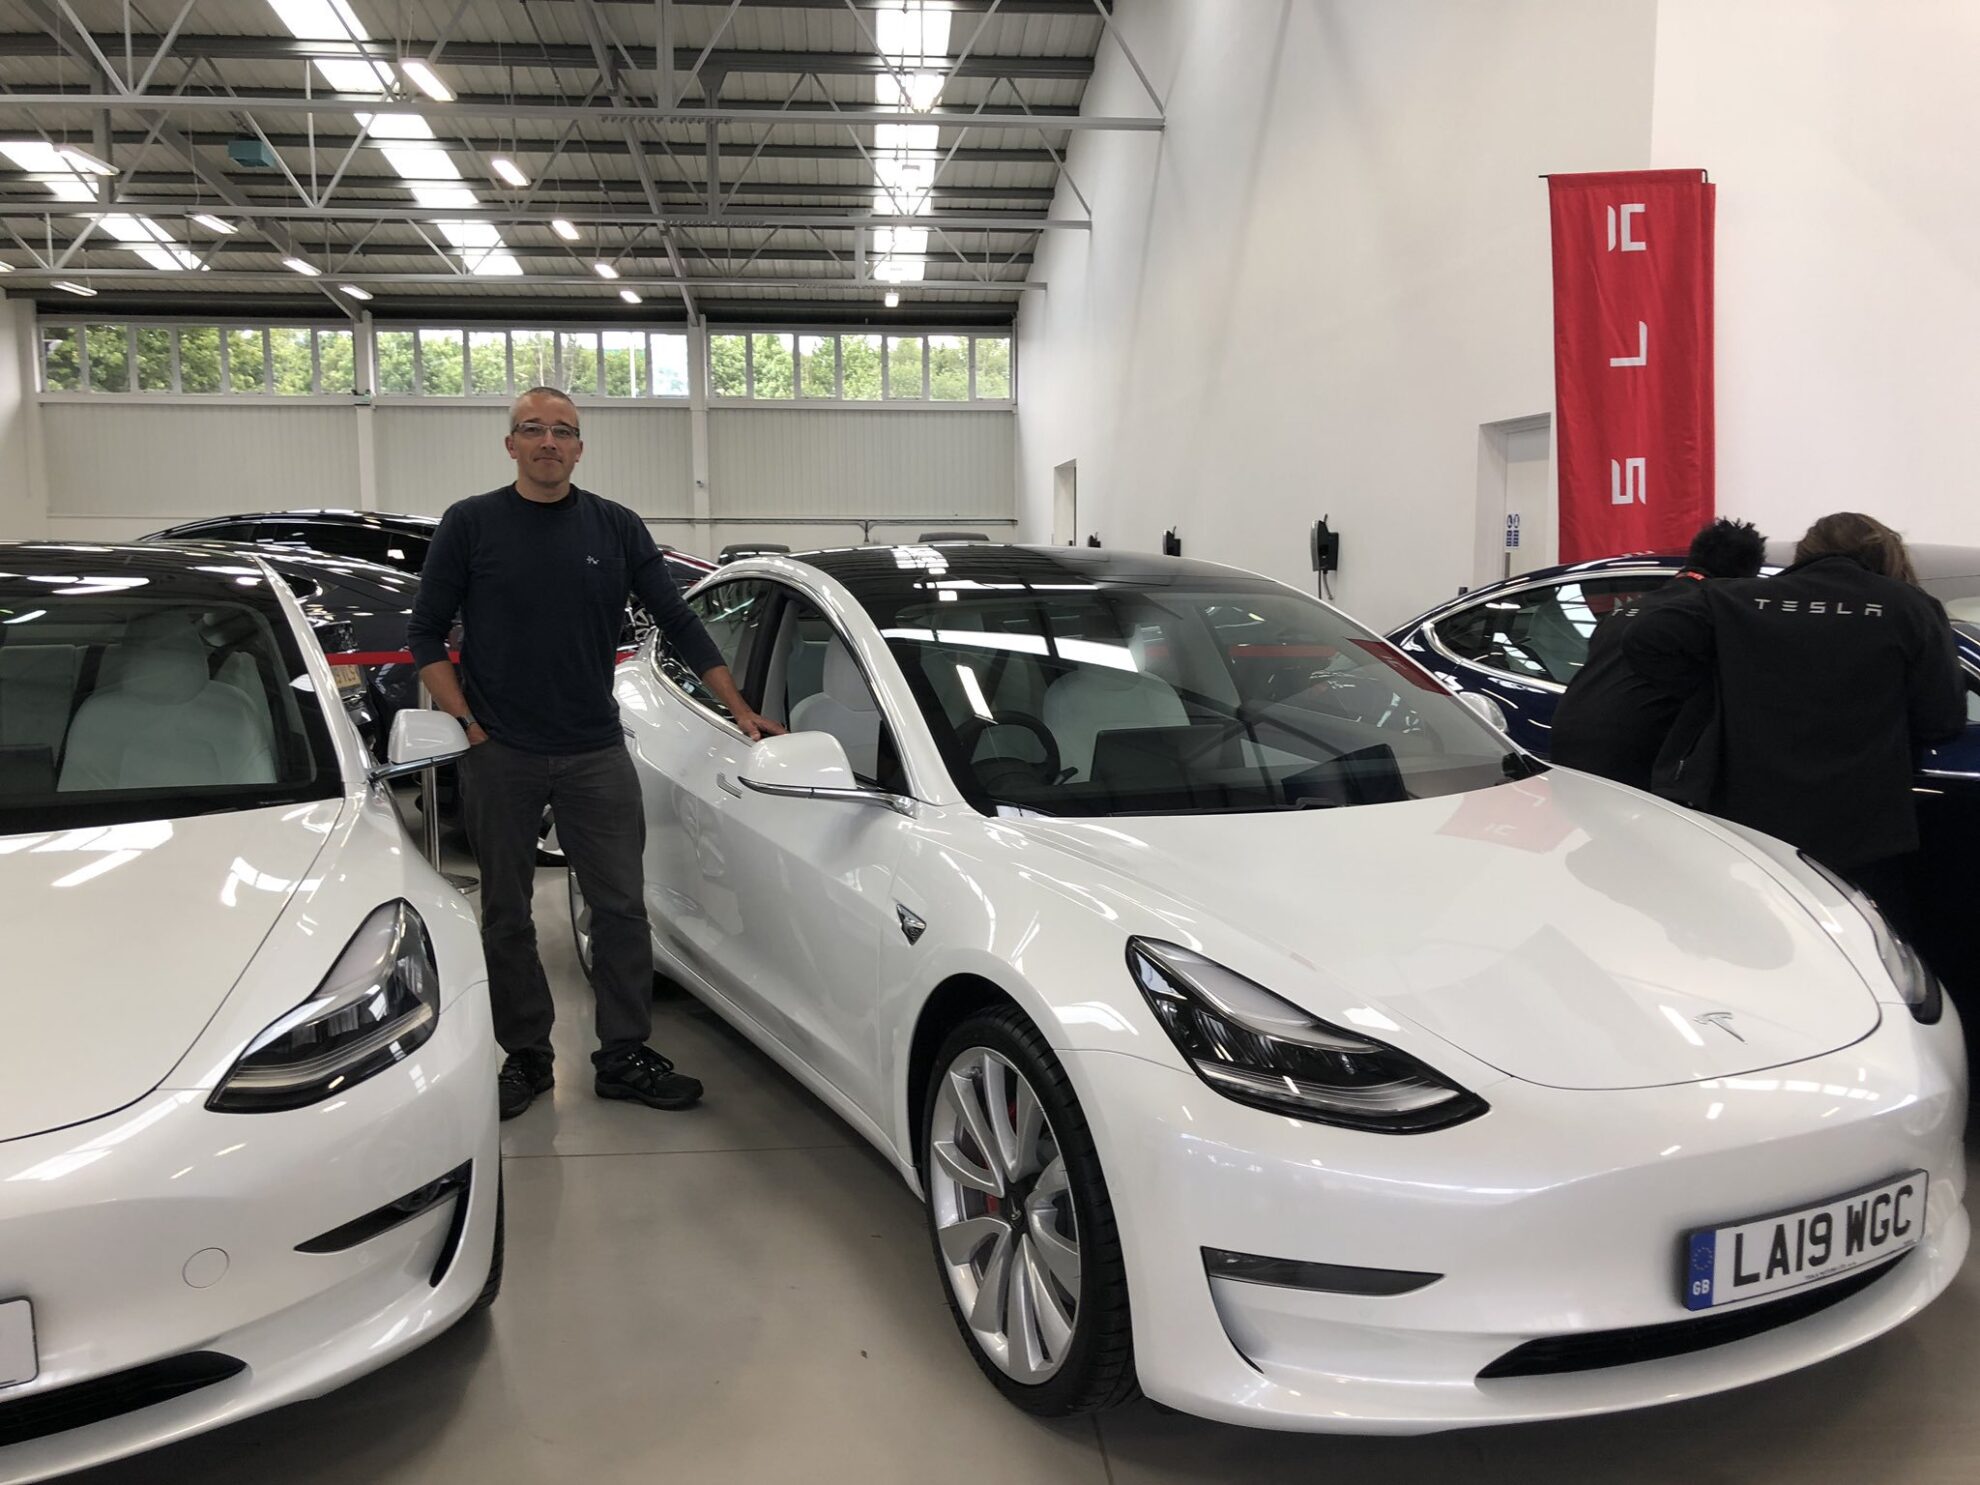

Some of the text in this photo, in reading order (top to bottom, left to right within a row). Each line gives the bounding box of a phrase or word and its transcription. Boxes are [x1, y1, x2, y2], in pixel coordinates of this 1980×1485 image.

[1607, 203, 1648, 505] SLA
[1753, 598, 1884, 617] TESLA
[1733, 1184, 1914, 1288] LA19 WGC
[1692, 1279, 1711, 1296] GB
